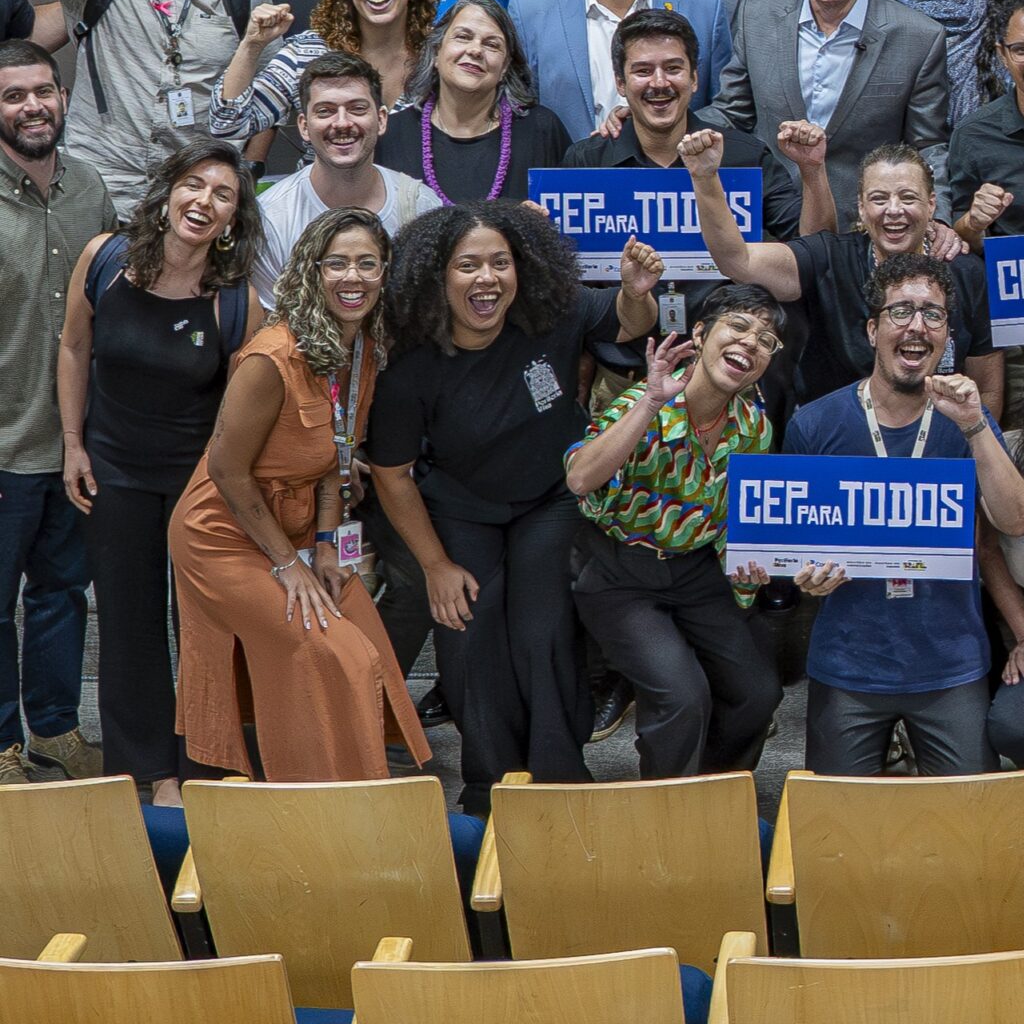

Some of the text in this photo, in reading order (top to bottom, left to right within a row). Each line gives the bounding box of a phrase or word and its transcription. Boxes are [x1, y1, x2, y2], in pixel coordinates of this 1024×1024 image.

[540, 191, 751, 234] CEP PARA TODS
[739, 479, 964, 528] CEP PARA TODOS
